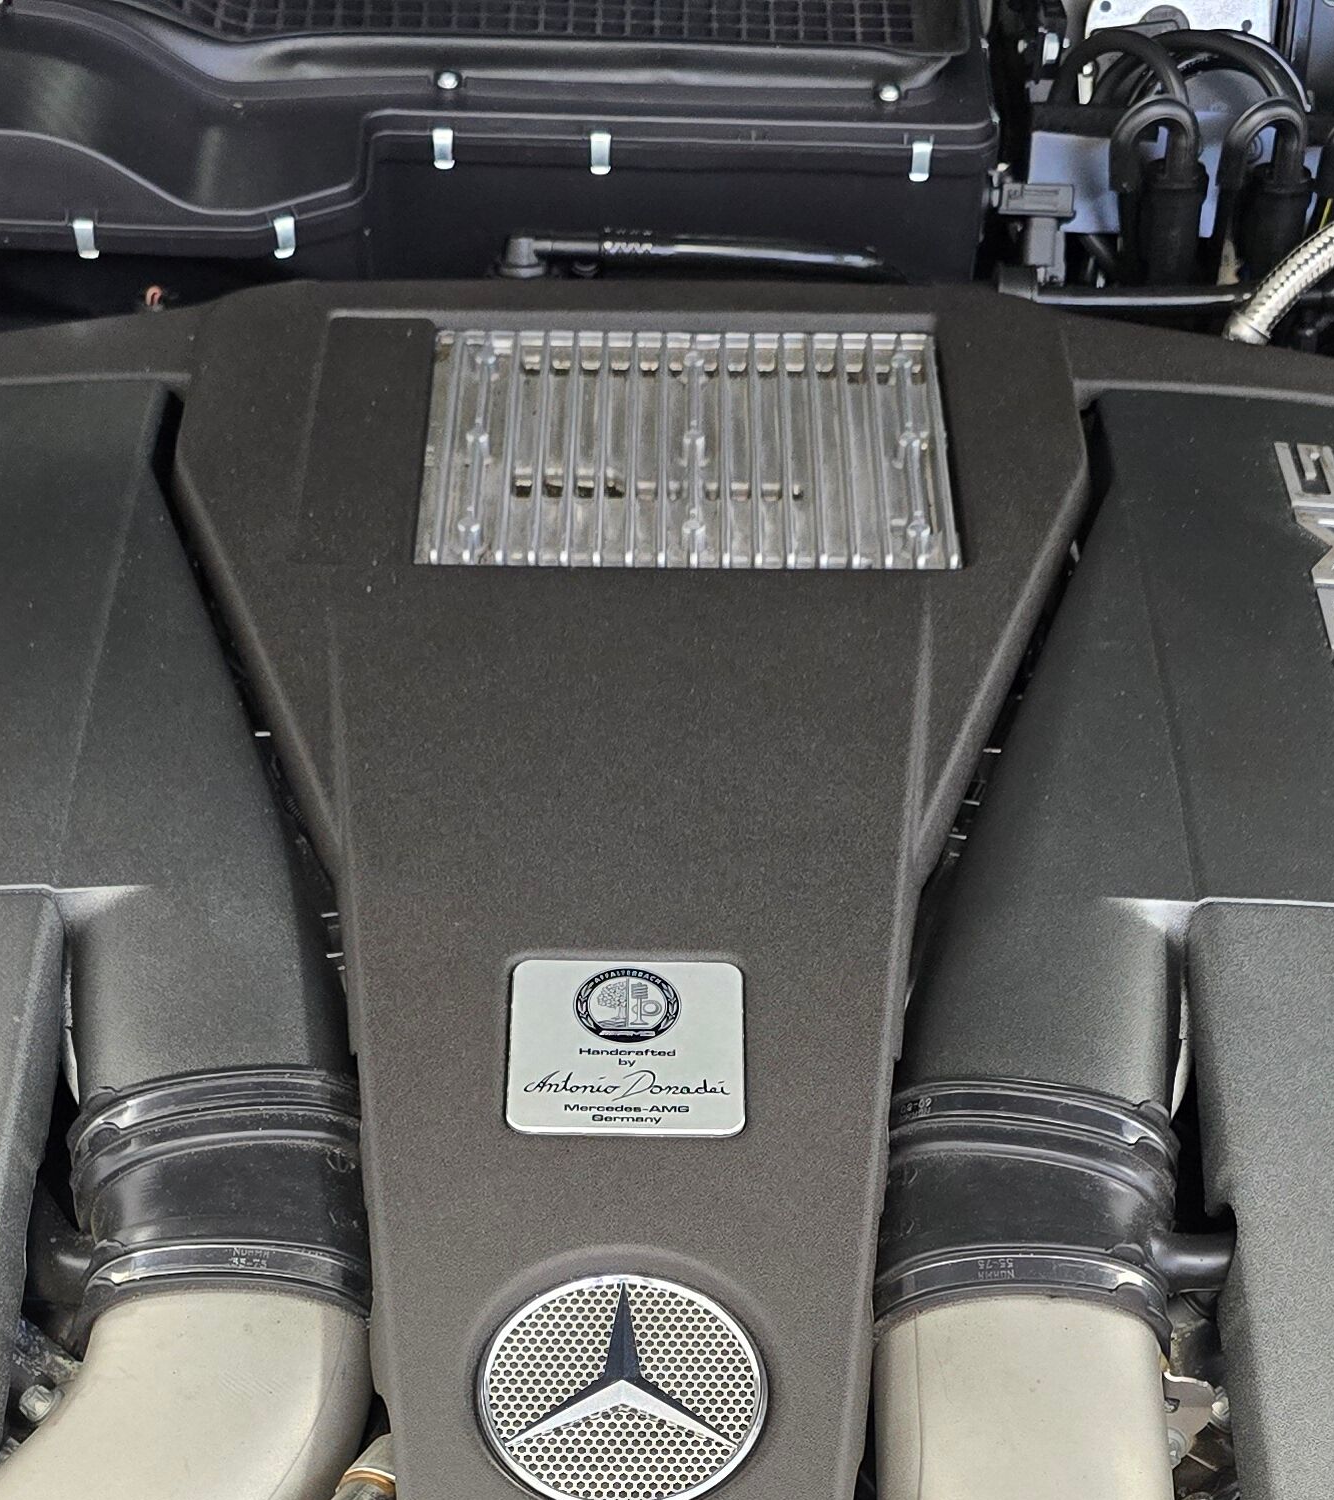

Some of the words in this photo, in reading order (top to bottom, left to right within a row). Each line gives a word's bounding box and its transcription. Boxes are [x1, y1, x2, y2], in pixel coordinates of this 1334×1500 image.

[579, 1047, 676, 1057] Handcrafted
[618, 1058, 636, 1068] by
[523, 1070, 620, 1094] Antonio
[564, 1104, 690, 1113] Mercedes-AMG
[592, 1114, 662, 1124] Germany
